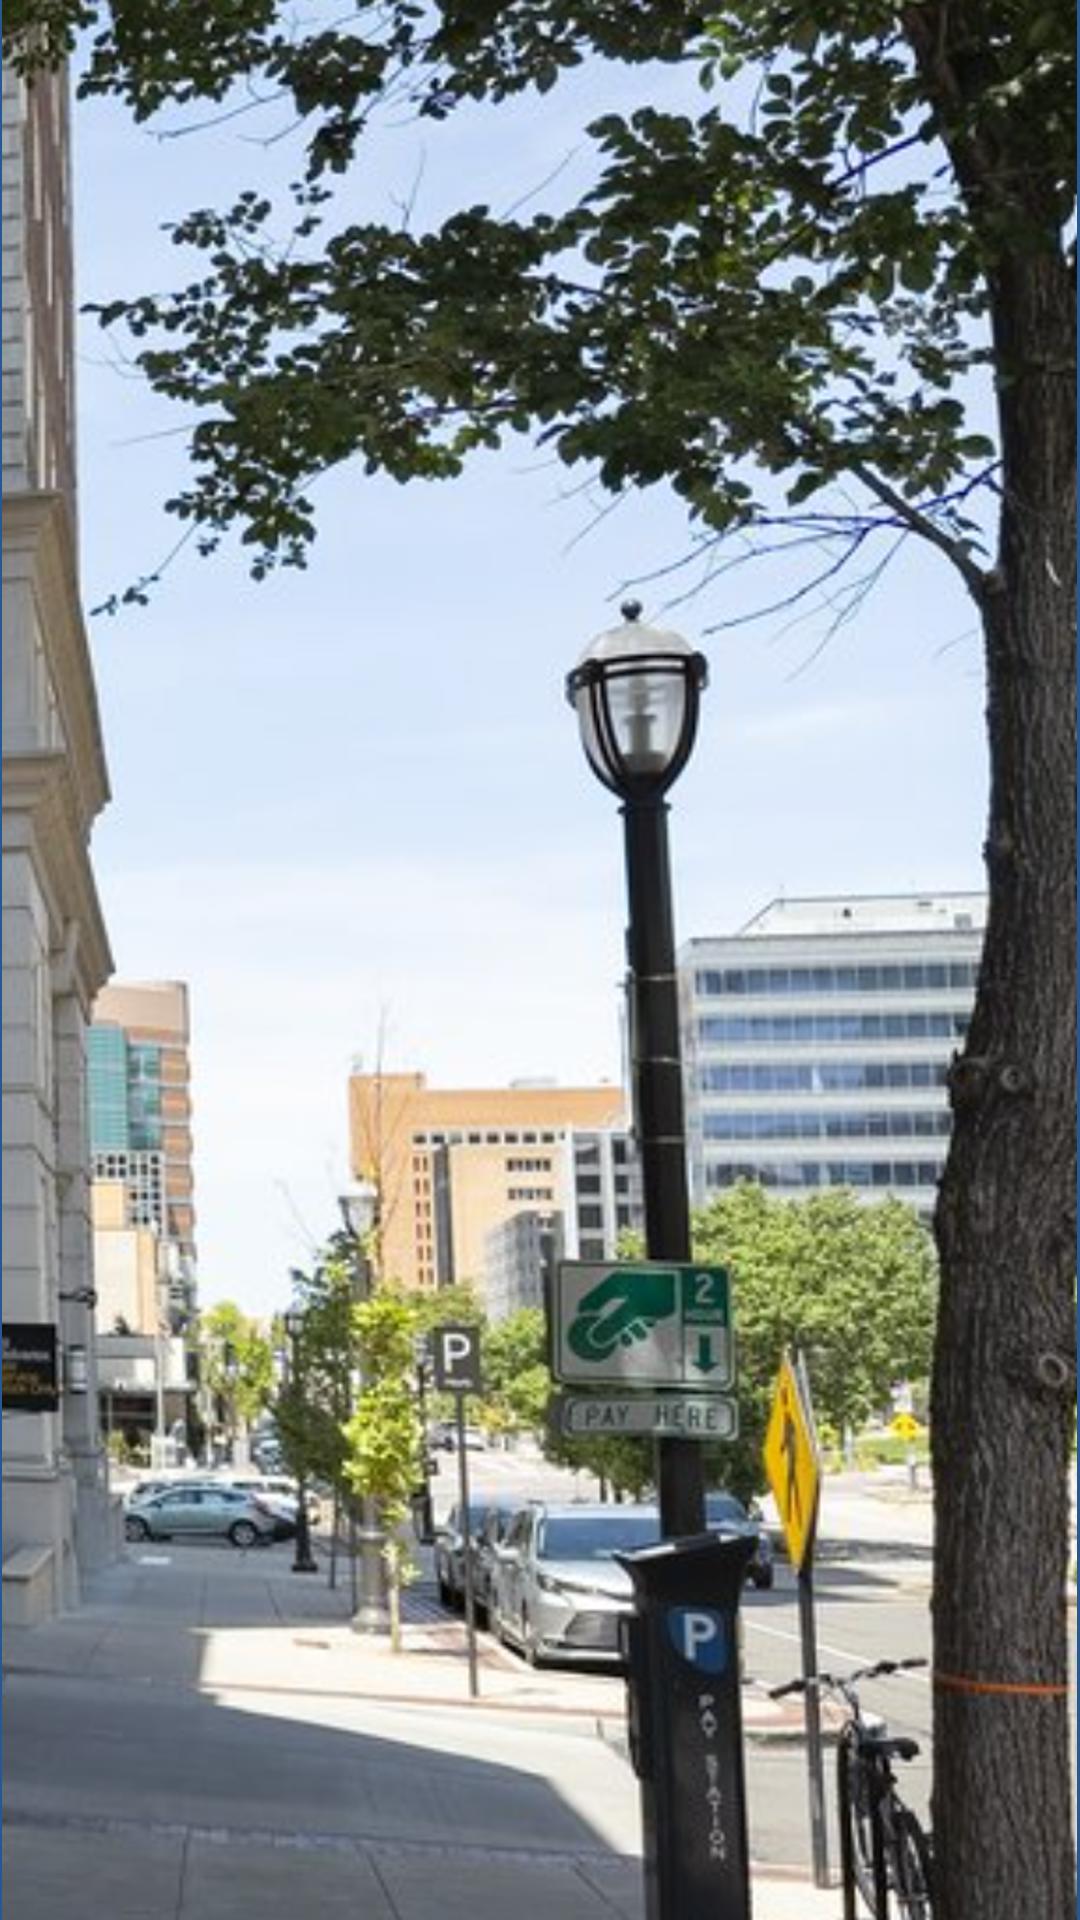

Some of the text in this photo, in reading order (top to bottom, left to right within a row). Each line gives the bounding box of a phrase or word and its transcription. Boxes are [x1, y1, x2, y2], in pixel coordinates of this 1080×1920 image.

[695, 1273, 715, 1303] 2
[443, 1333, 470, 1373] P
[585, 1403, 717, 1430] PAY HERE
[682, 1612, 717, 1662] P
[699, 1694, 726, 1863] PAY STATION
